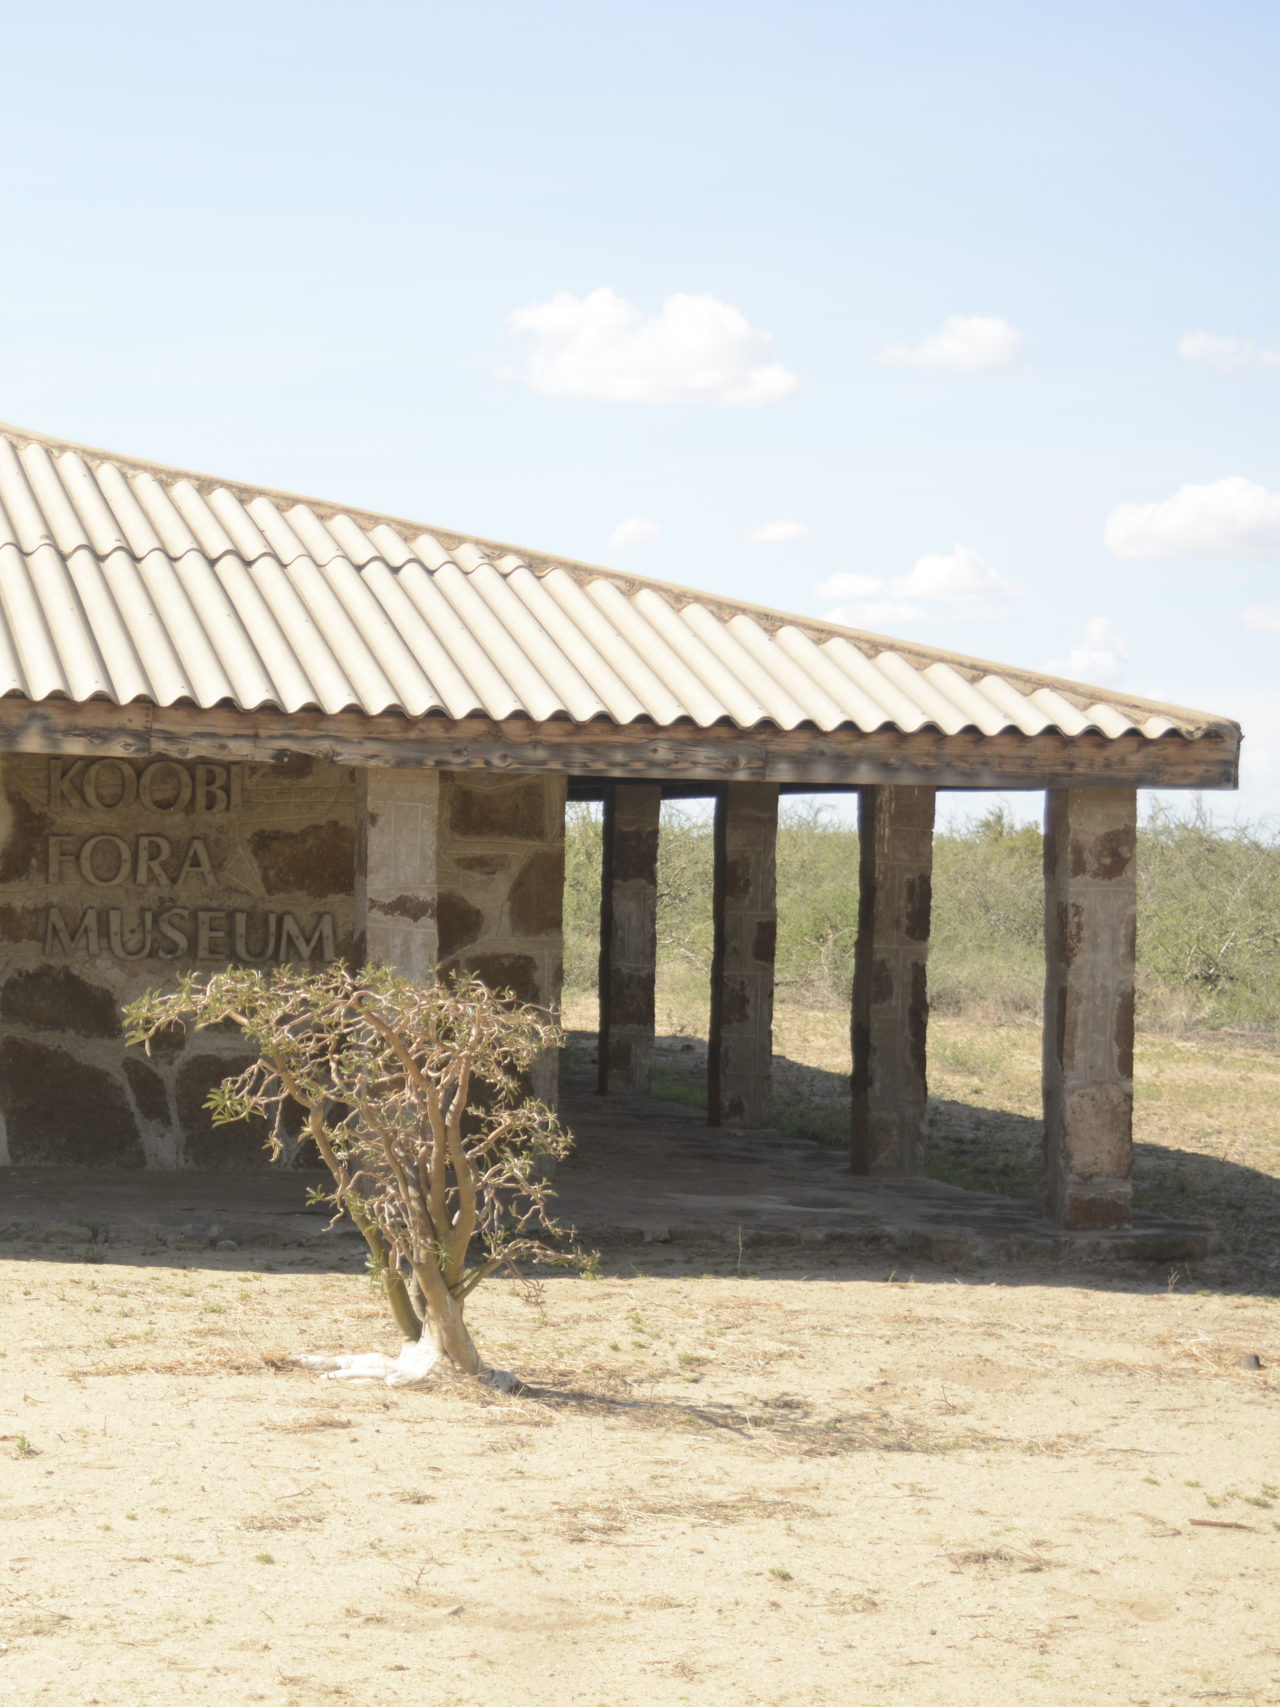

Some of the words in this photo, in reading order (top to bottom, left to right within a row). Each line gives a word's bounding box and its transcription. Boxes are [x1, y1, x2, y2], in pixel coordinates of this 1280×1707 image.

[49, 758, 243, 814] KOOBI
[48, 834, 218, 888] FORA
[44, 906, 336, 962] MUSEUM
